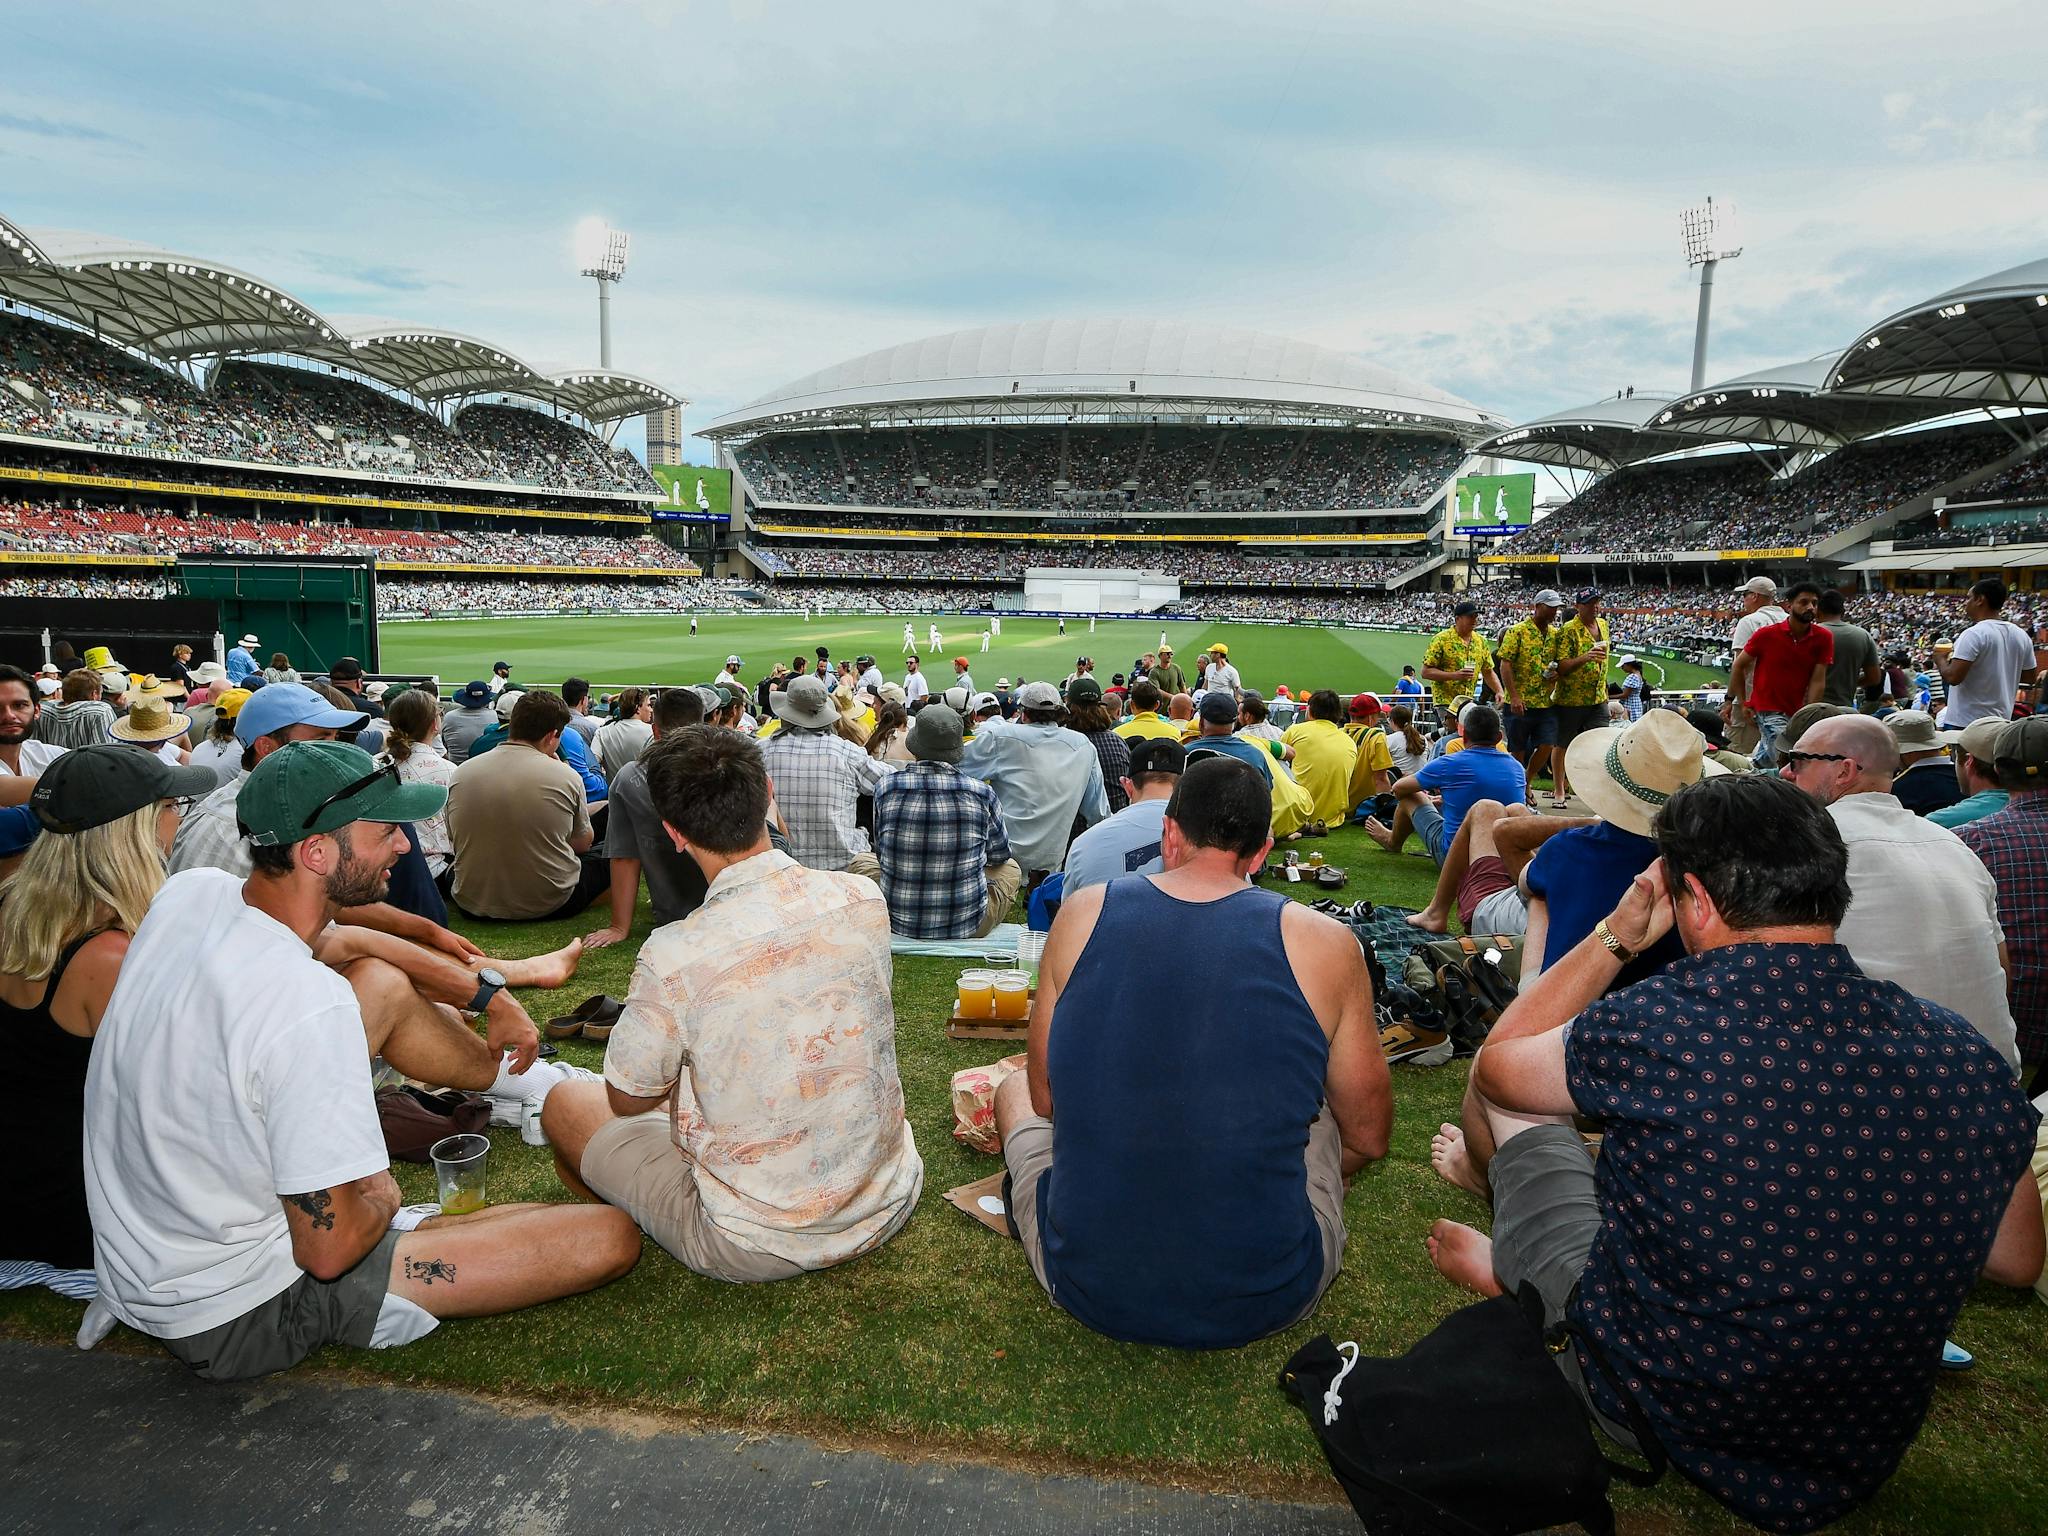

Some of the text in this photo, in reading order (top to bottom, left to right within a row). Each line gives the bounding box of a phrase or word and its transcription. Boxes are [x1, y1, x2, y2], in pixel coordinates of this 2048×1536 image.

[96, 444, 202, 463] MAX BASHEER STAND
[0, 469, 31, 479] FEARLESS
[67, 474, 127, 487] FOREVER FEARLESS
[388, 475, 422, 484] WILLIAMS
[425, 478, 447, 486] STAND
[159, 484, 214, 494] FOREVER FEARLESS
[562, 489, 592, 497] RICCIUTO
[1605, 553, 1674, 562] CHAPPELL STAND
[1770, 549, 1794, 557] FEARLESS
